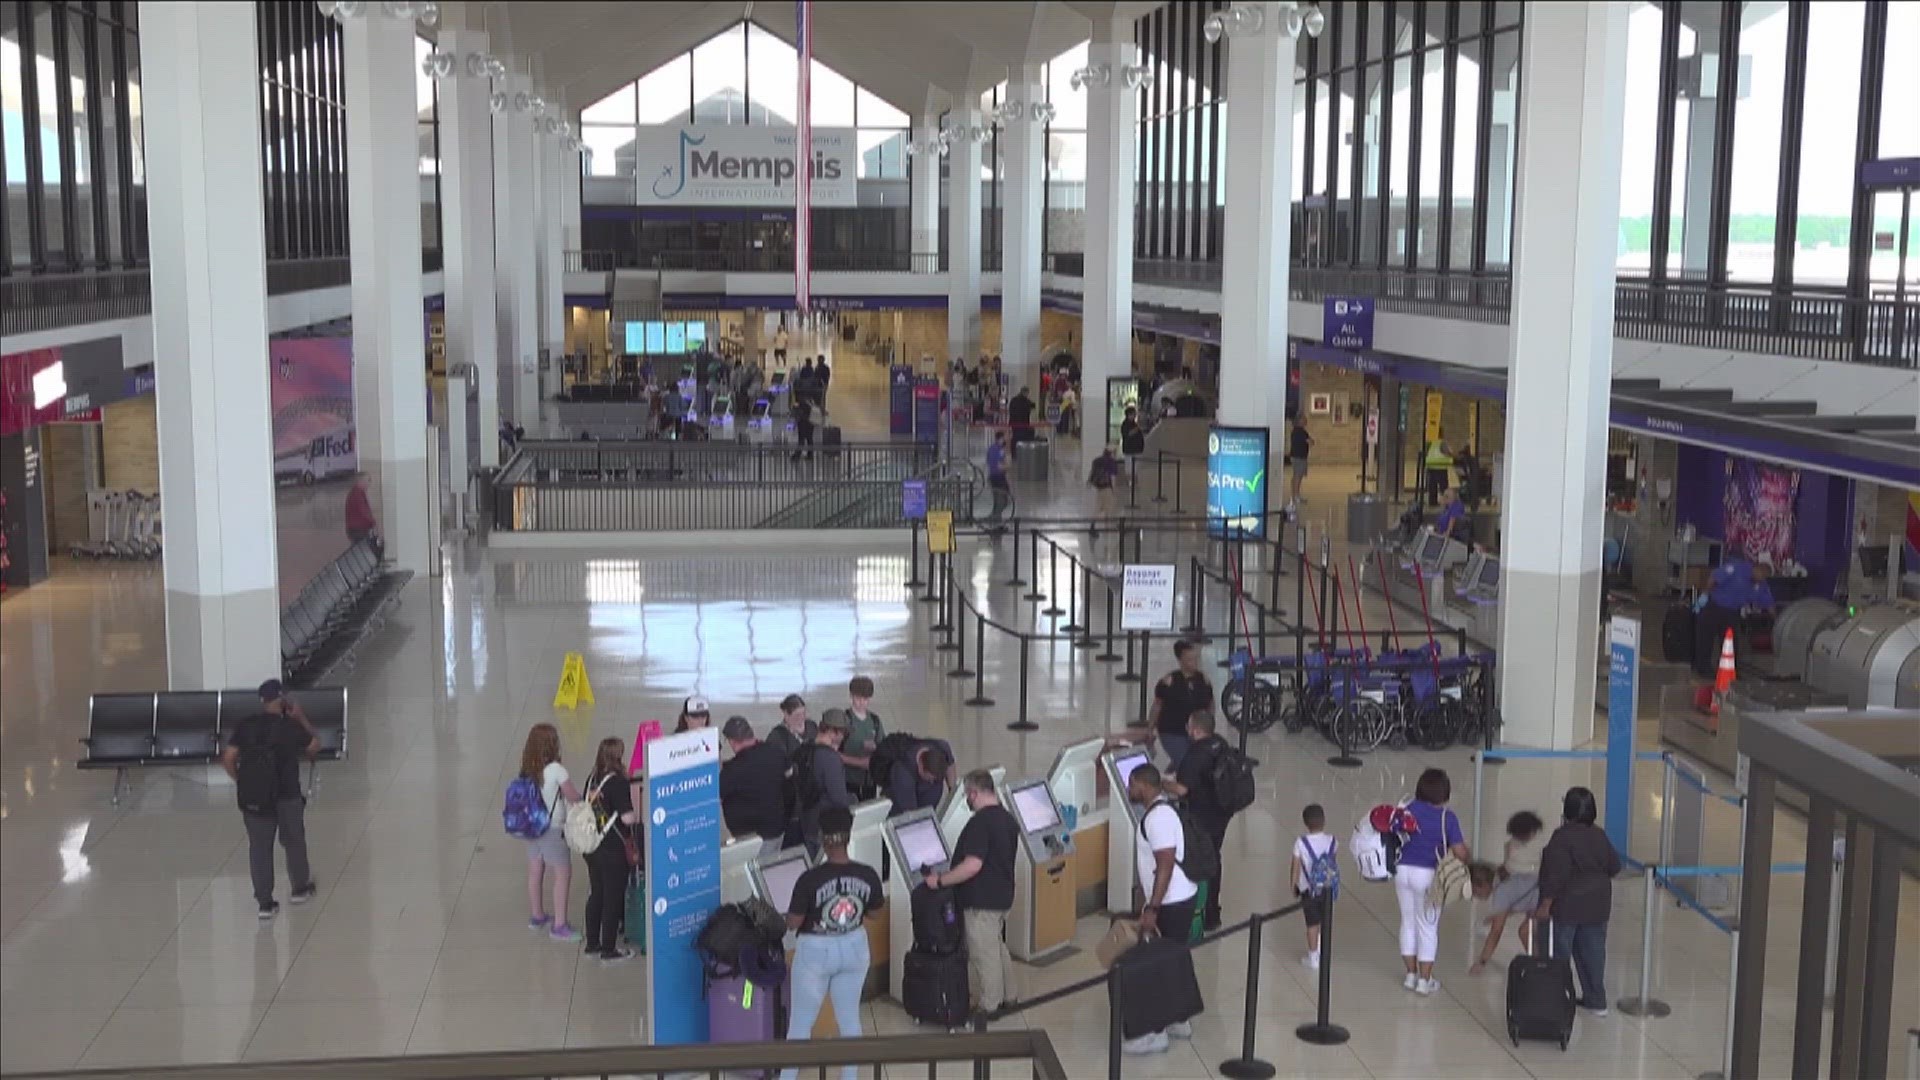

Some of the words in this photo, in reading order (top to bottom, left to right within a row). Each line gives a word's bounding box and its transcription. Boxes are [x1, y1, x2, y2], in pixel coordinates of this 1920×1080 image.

[691, 150, 841, 187] Mempis
[690, 190, 785, 199] INTERNATIONAL
[1341, 323, 1355, 334] All
[1332, 335, 1363, 347] Gates
[1222, 474, 1244, 490] Pre
[1126, 569, 1160, 578] Baggage
[668, 745, 700, 759] American
[656, 774, 712, 799] SELF-SERVICE
